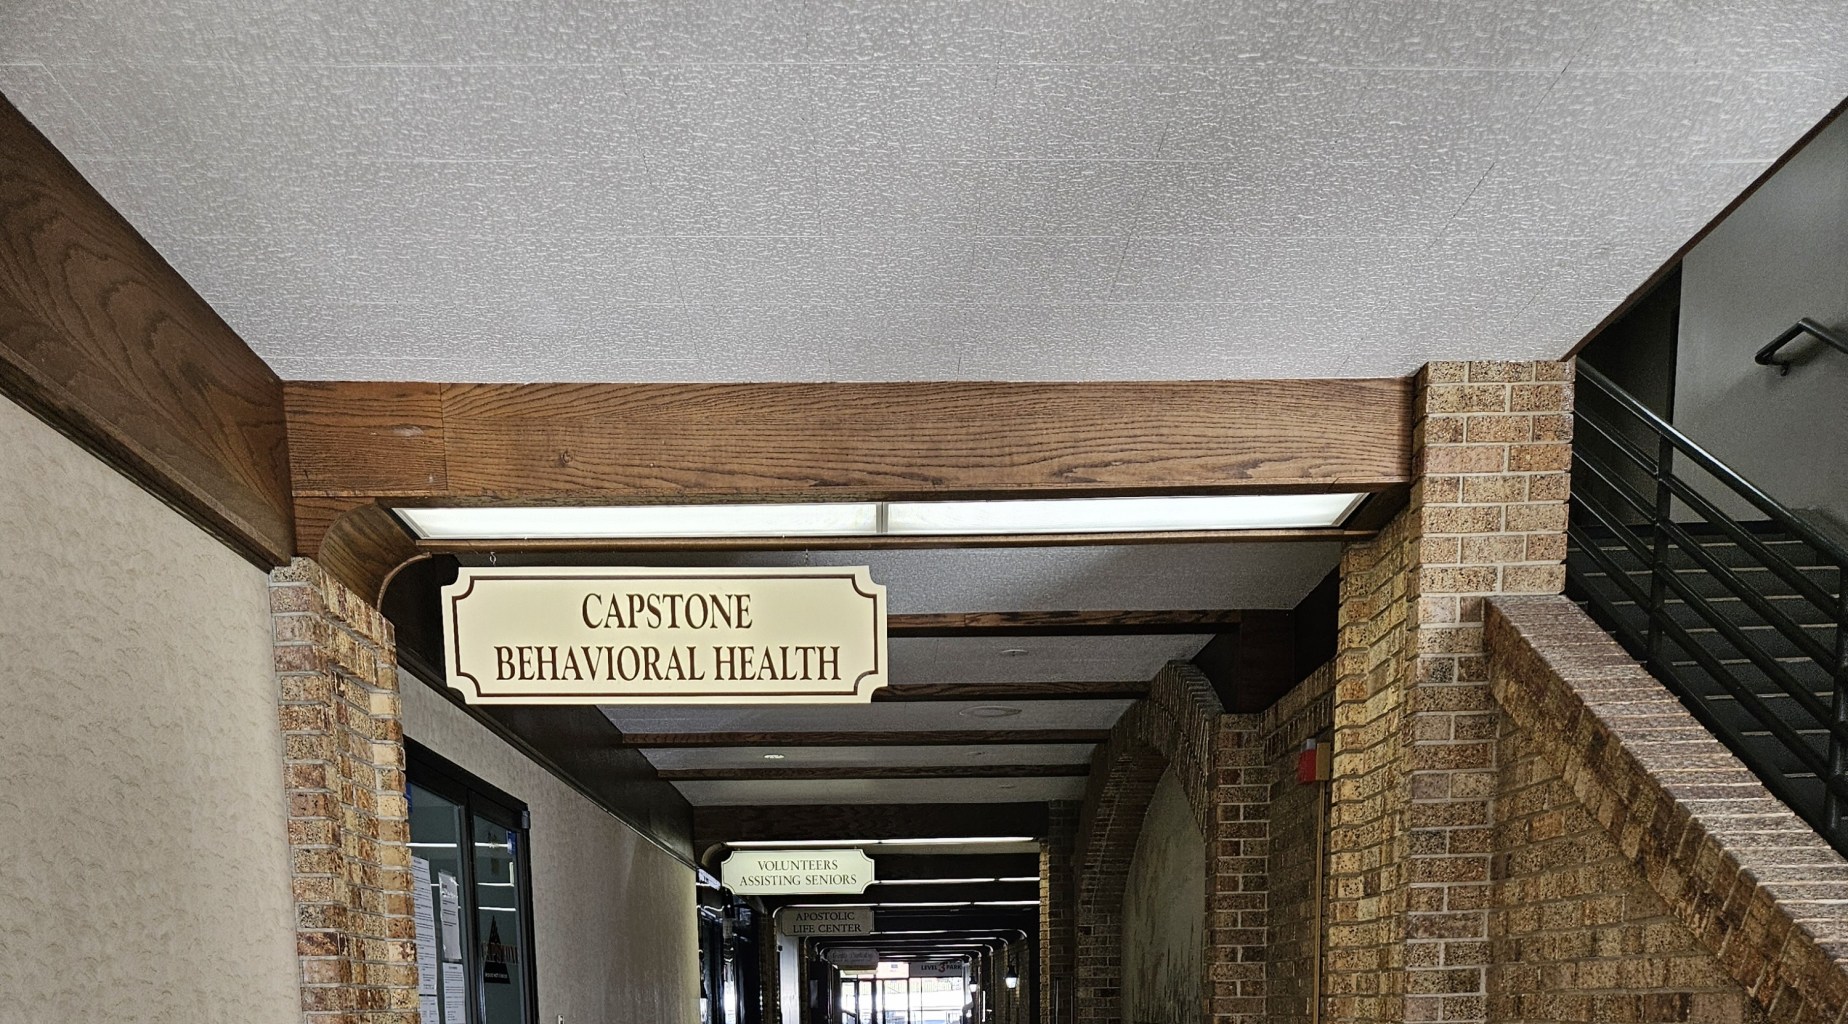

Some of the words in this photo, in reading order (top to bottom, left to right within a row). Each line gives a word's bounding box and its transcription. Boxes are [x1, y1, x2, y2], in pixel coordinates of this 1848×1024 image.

[582, 593, 753, 629] CAPSTONE
[494, 645, 706, 680] BEHAVIORAL
[713, 645, 842, 681] HEALTH
[757, 860, 838, 871] VOLUNTEERS
[739, 875, 801, 886] ASSISTING
[805, 874, 857, 885] SENIORS
[796, 911, 855, 921] APOSTOLIC
[793, 924, 815, 933] LIFE
[818, 923, 861, 933] CENTER
